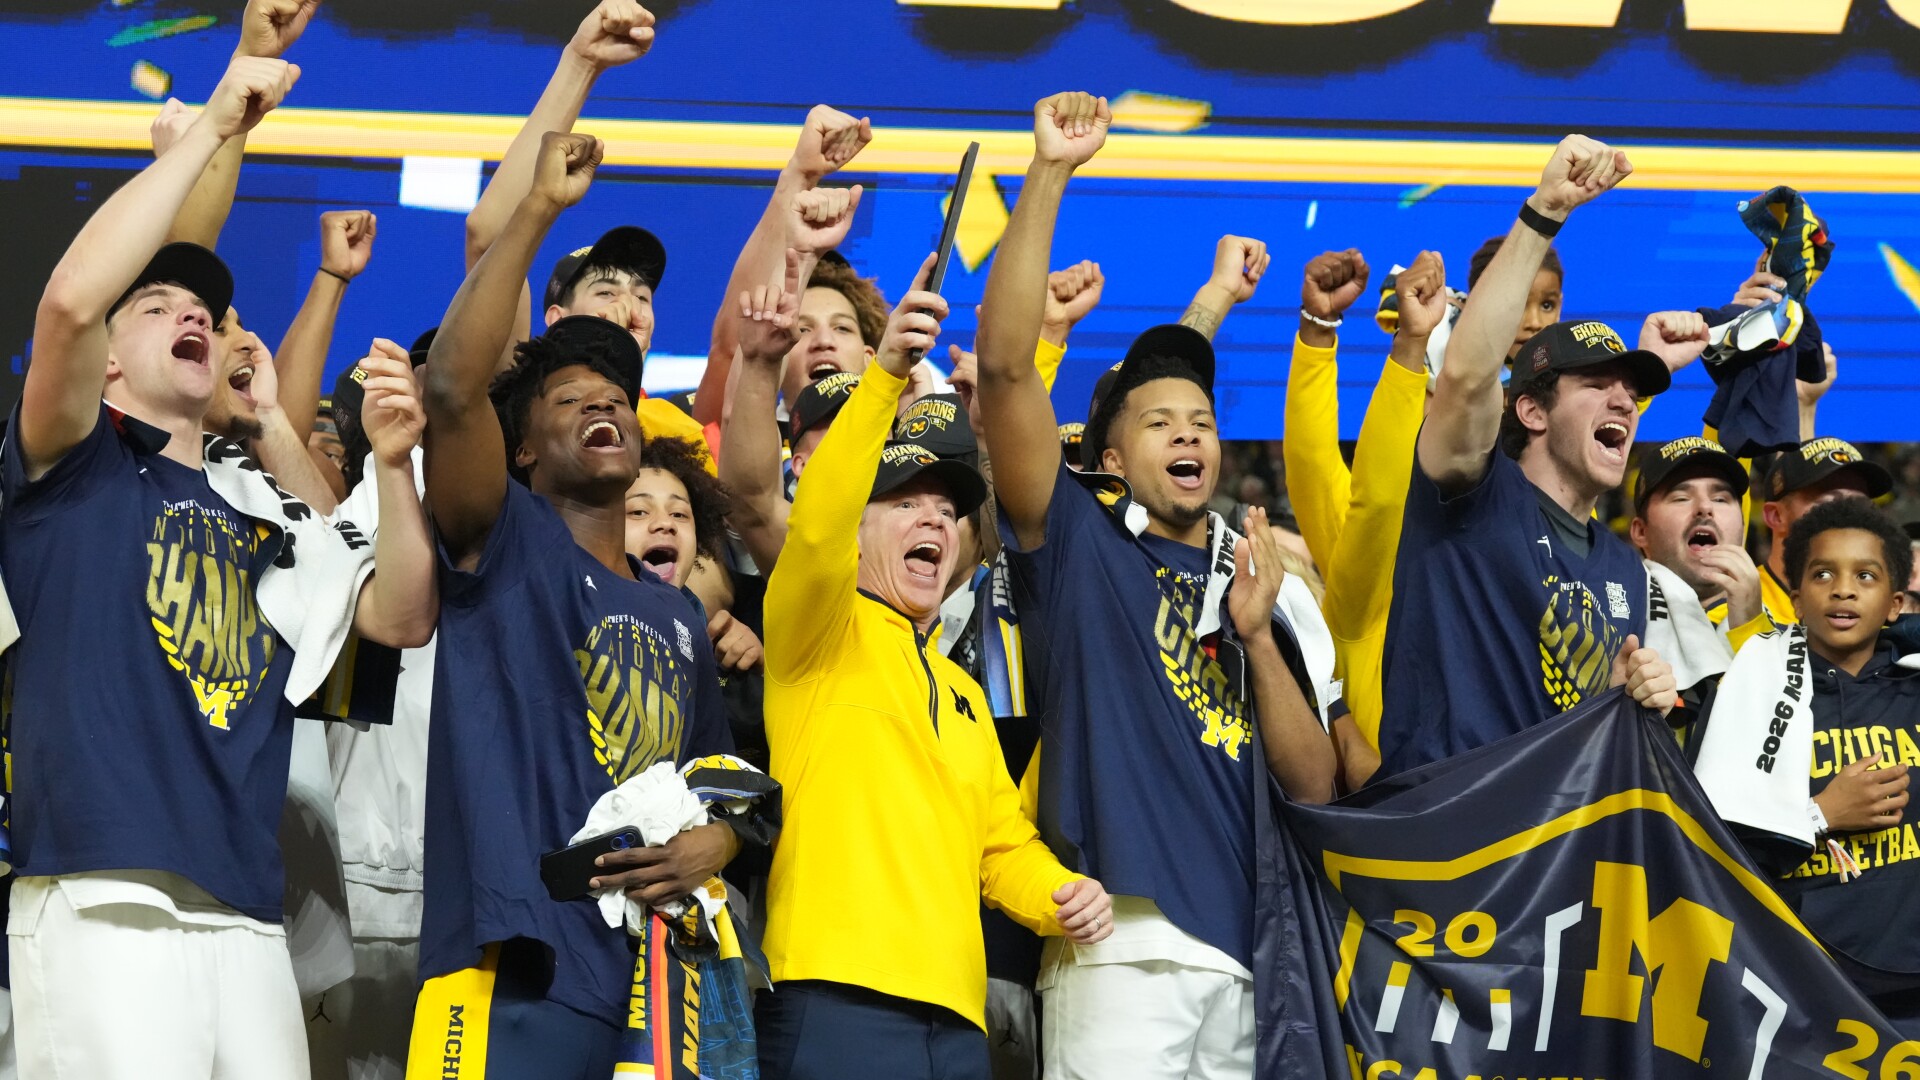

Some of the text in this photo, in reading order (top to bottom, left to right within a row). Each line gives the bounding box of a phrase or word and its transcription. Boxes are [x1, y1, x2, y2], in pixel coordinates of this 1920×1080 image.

[910, 420, 926, 433] M
[190, 679, 231, 731] M
[1756, 701, 1794, 774] 2026
[1783, 641, 1808, 702] NCAA
[1200, 708, 1246, 762] M
[1809, 724, 1920, 779] CHIGA
[1782, 823, 1920, 879] ASKETBA
[1392, 909, 1497, 958] 20
[1580, 861, 1735, 1064] M
[1822, 1018, 1920, 1080] 26
